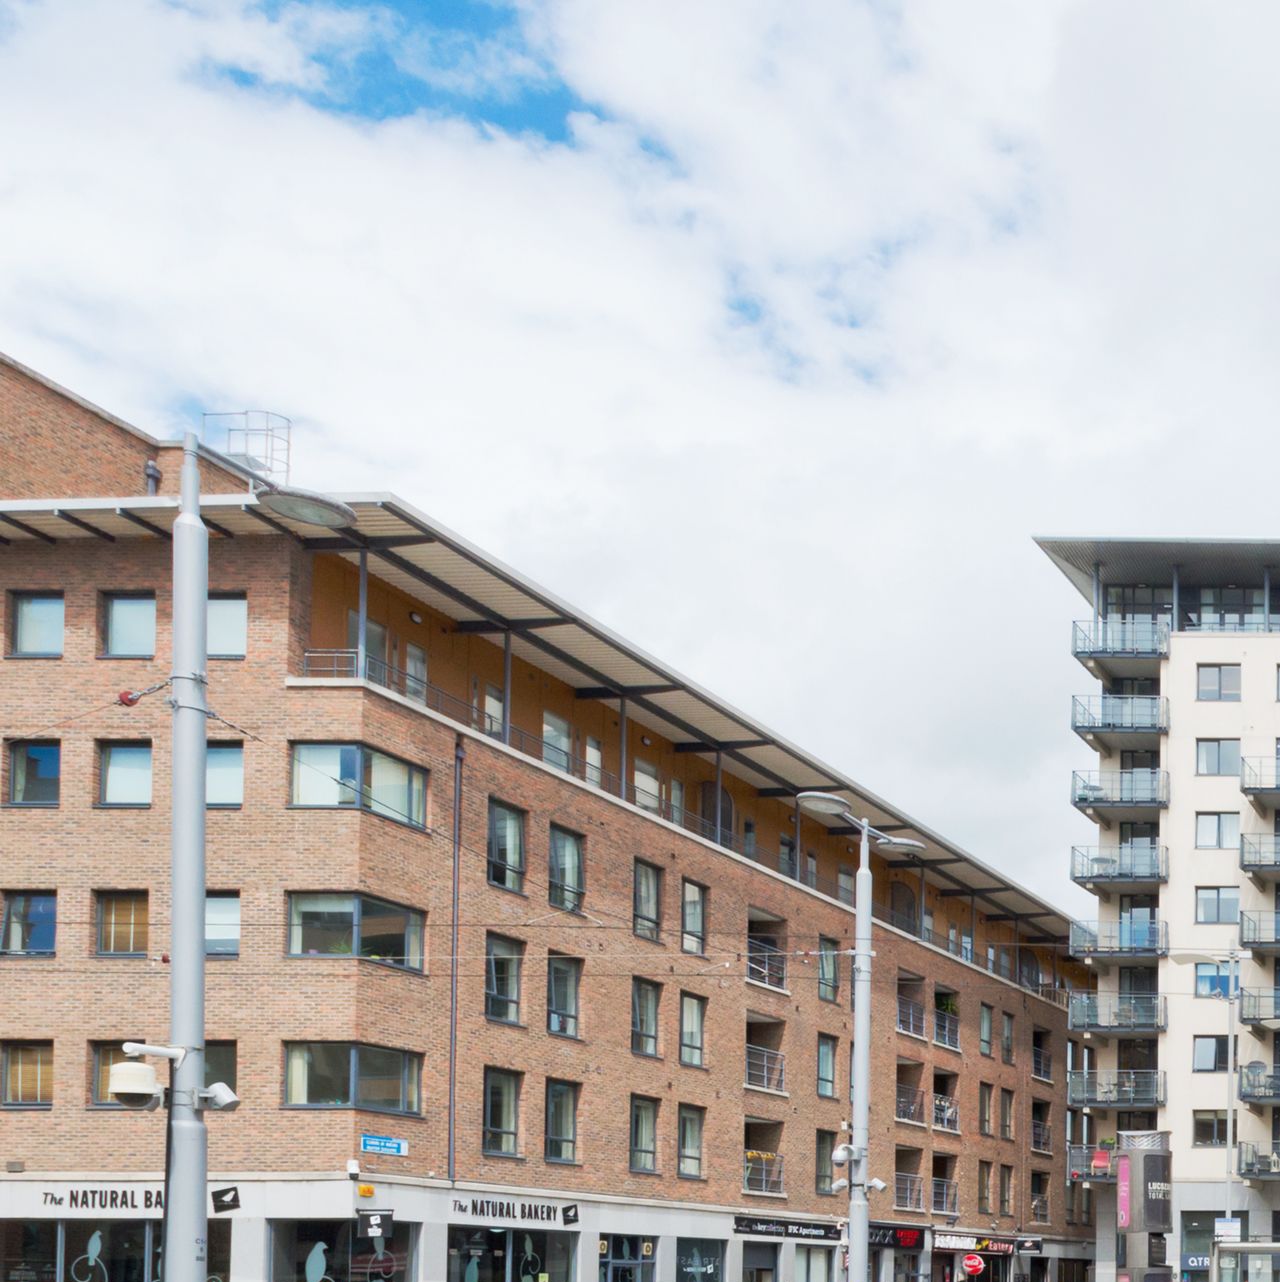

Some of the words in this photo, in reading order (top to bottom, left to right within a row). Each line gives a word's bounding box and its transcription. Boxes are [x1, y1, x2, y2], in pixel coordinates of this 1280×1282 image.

[43, 1192, 64, 1206] The
[69, 1190, 138, 1209] NATURAL
[144, 1190, 164, 1209] BA
[453, 1200, 468, 1213] The
[471, 1199, 517, 1219] NATURAL
[520, 1203, 558, 1221] BAKERY
